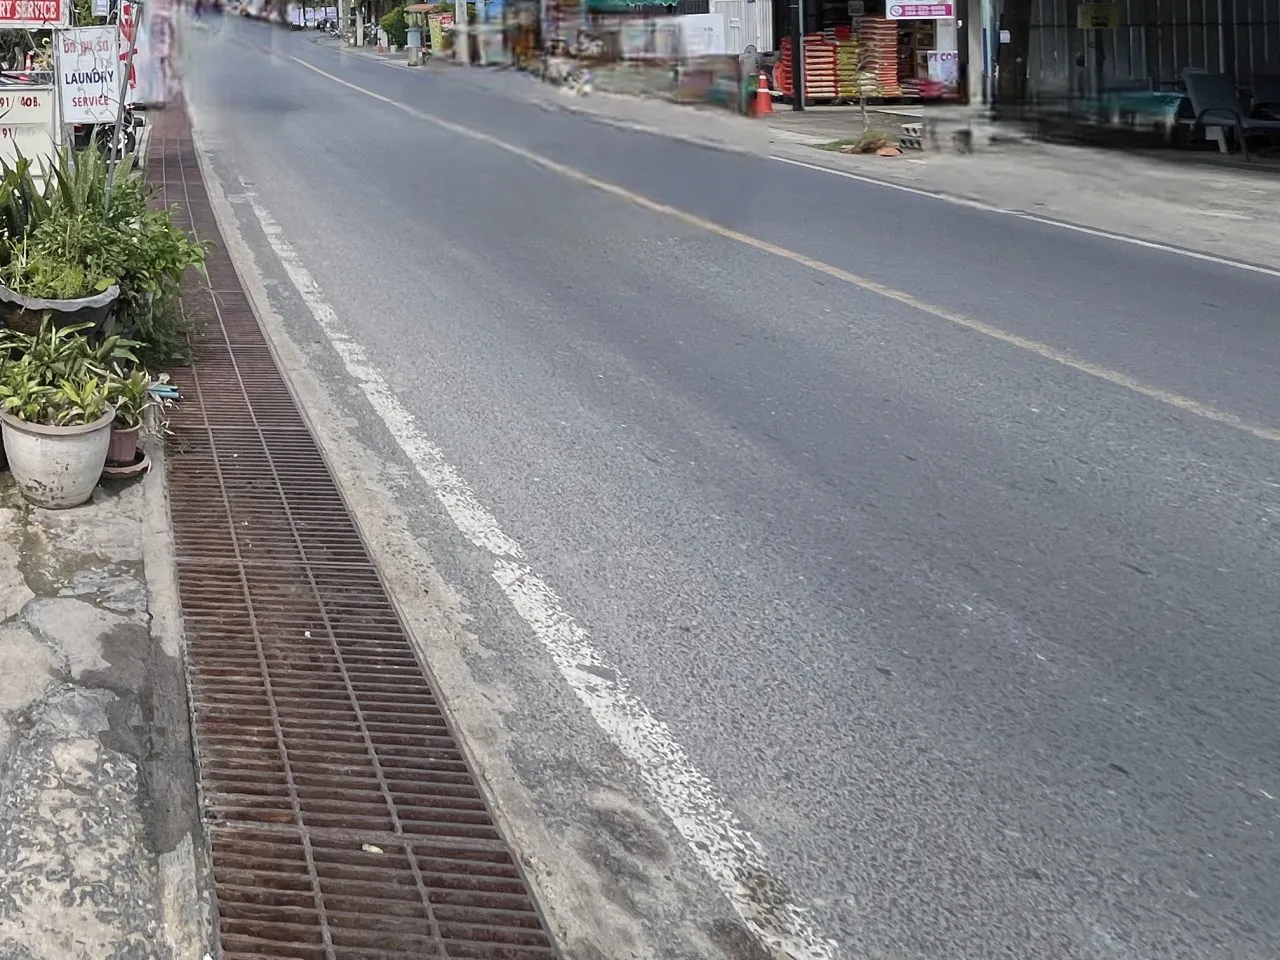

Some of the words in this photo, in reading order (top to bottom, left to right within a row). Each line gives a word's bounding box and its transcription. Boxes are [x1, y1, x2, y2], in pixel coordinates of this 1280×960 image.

[928, 52, 939, 62] PT
[65, 71, 114, 85] LAUNDRY
[72, 95, 109, 107] SERVICE
